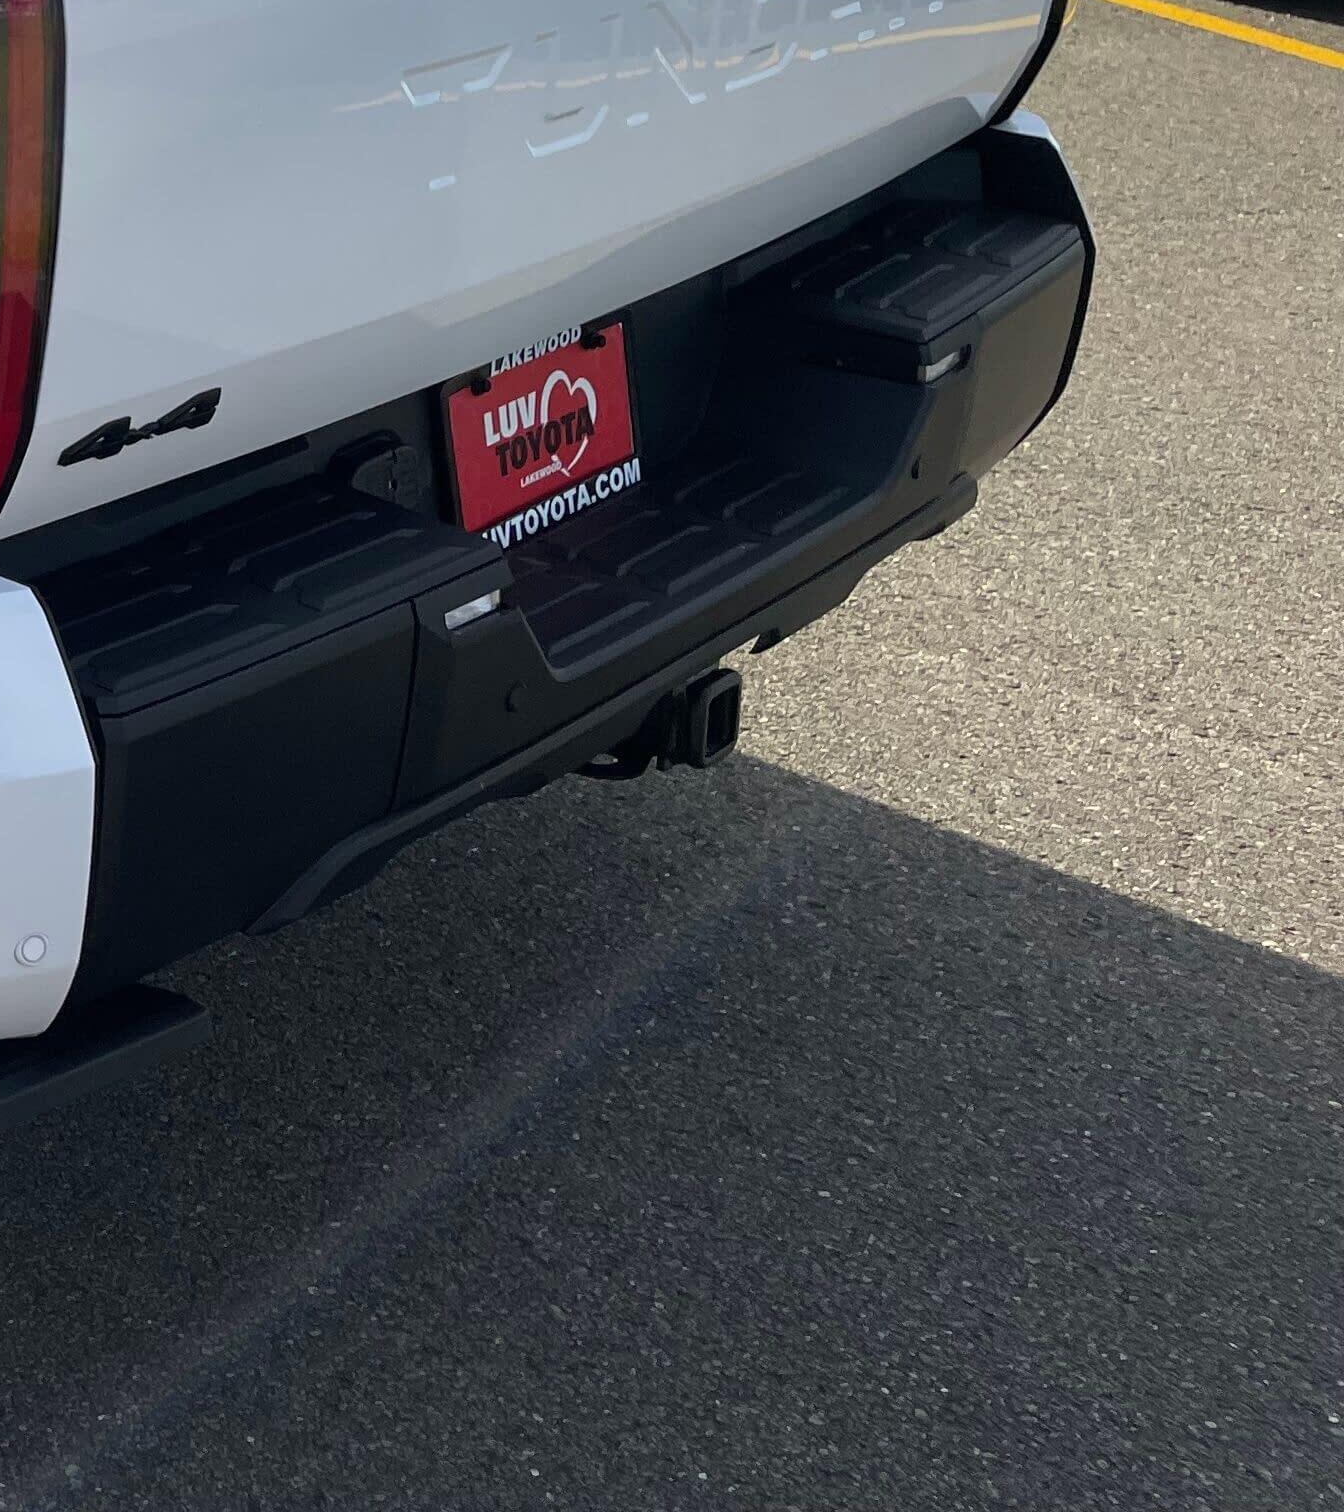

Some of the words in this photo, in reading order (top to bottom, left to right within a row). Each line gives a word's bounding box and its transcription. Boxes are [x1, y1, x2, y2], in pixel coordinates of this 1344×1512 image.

[490, 326, 583, 377] LAKEWOOD
[483, 391, 537, 447] LUV
[495, 406, 595, 477] TOYOTA
[520, 462, 563, 488] LAKEWOOD
